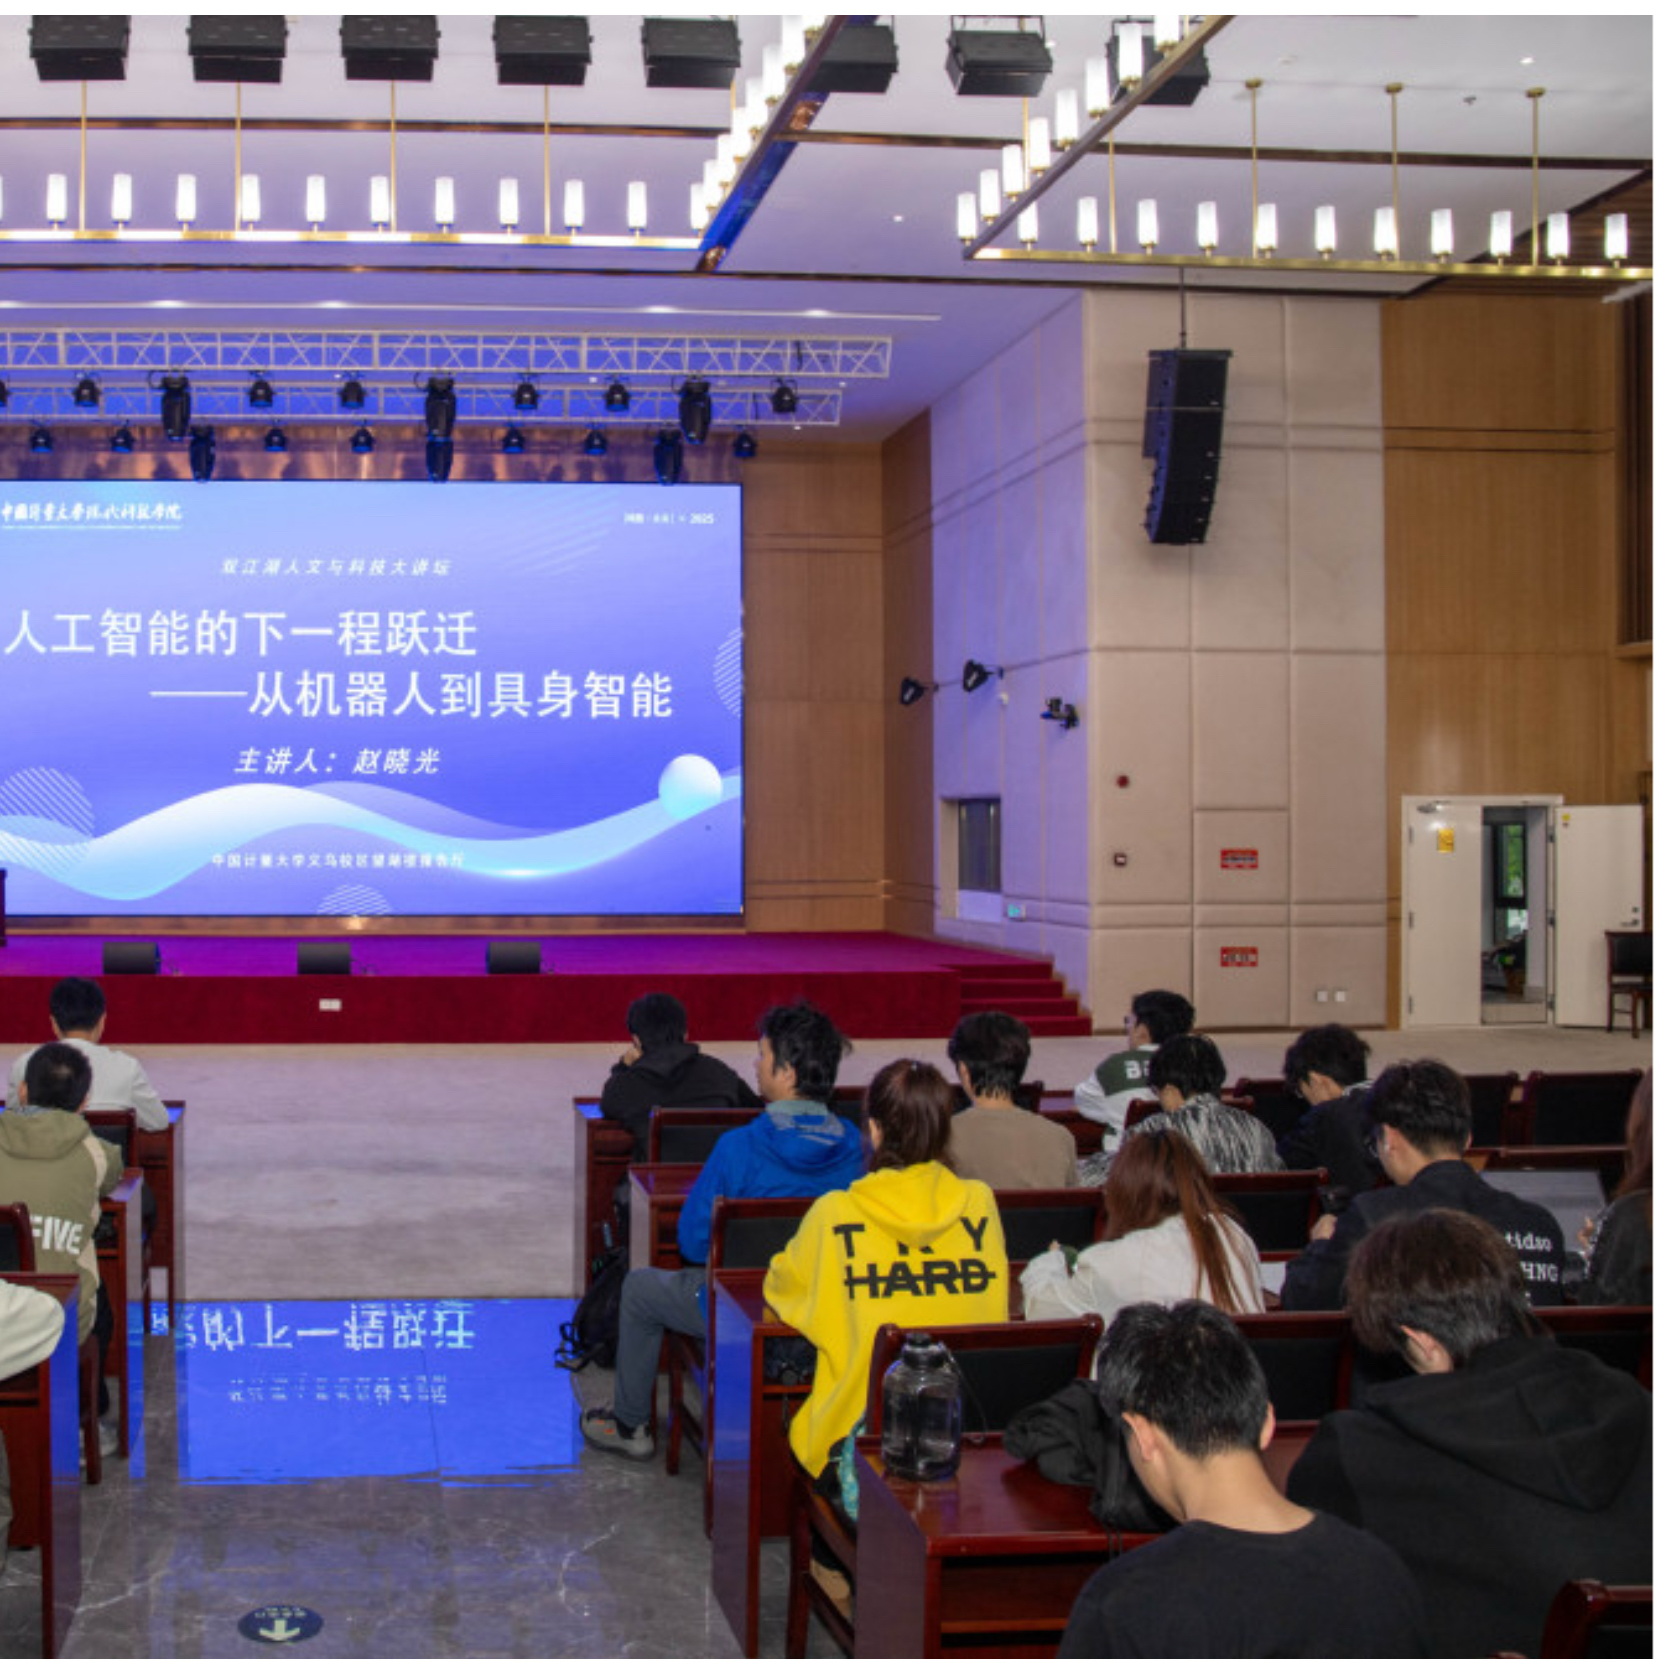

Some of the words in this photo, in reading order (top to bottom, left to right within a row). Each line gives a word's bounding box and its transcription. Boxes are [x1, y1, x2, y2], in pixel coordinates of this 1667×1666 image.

[3, 608, 480, 658] 人工智能的下一程跃迁
[832, 1216, 990, 1259] TY
[843, 1258, 998, 1301] HARD
